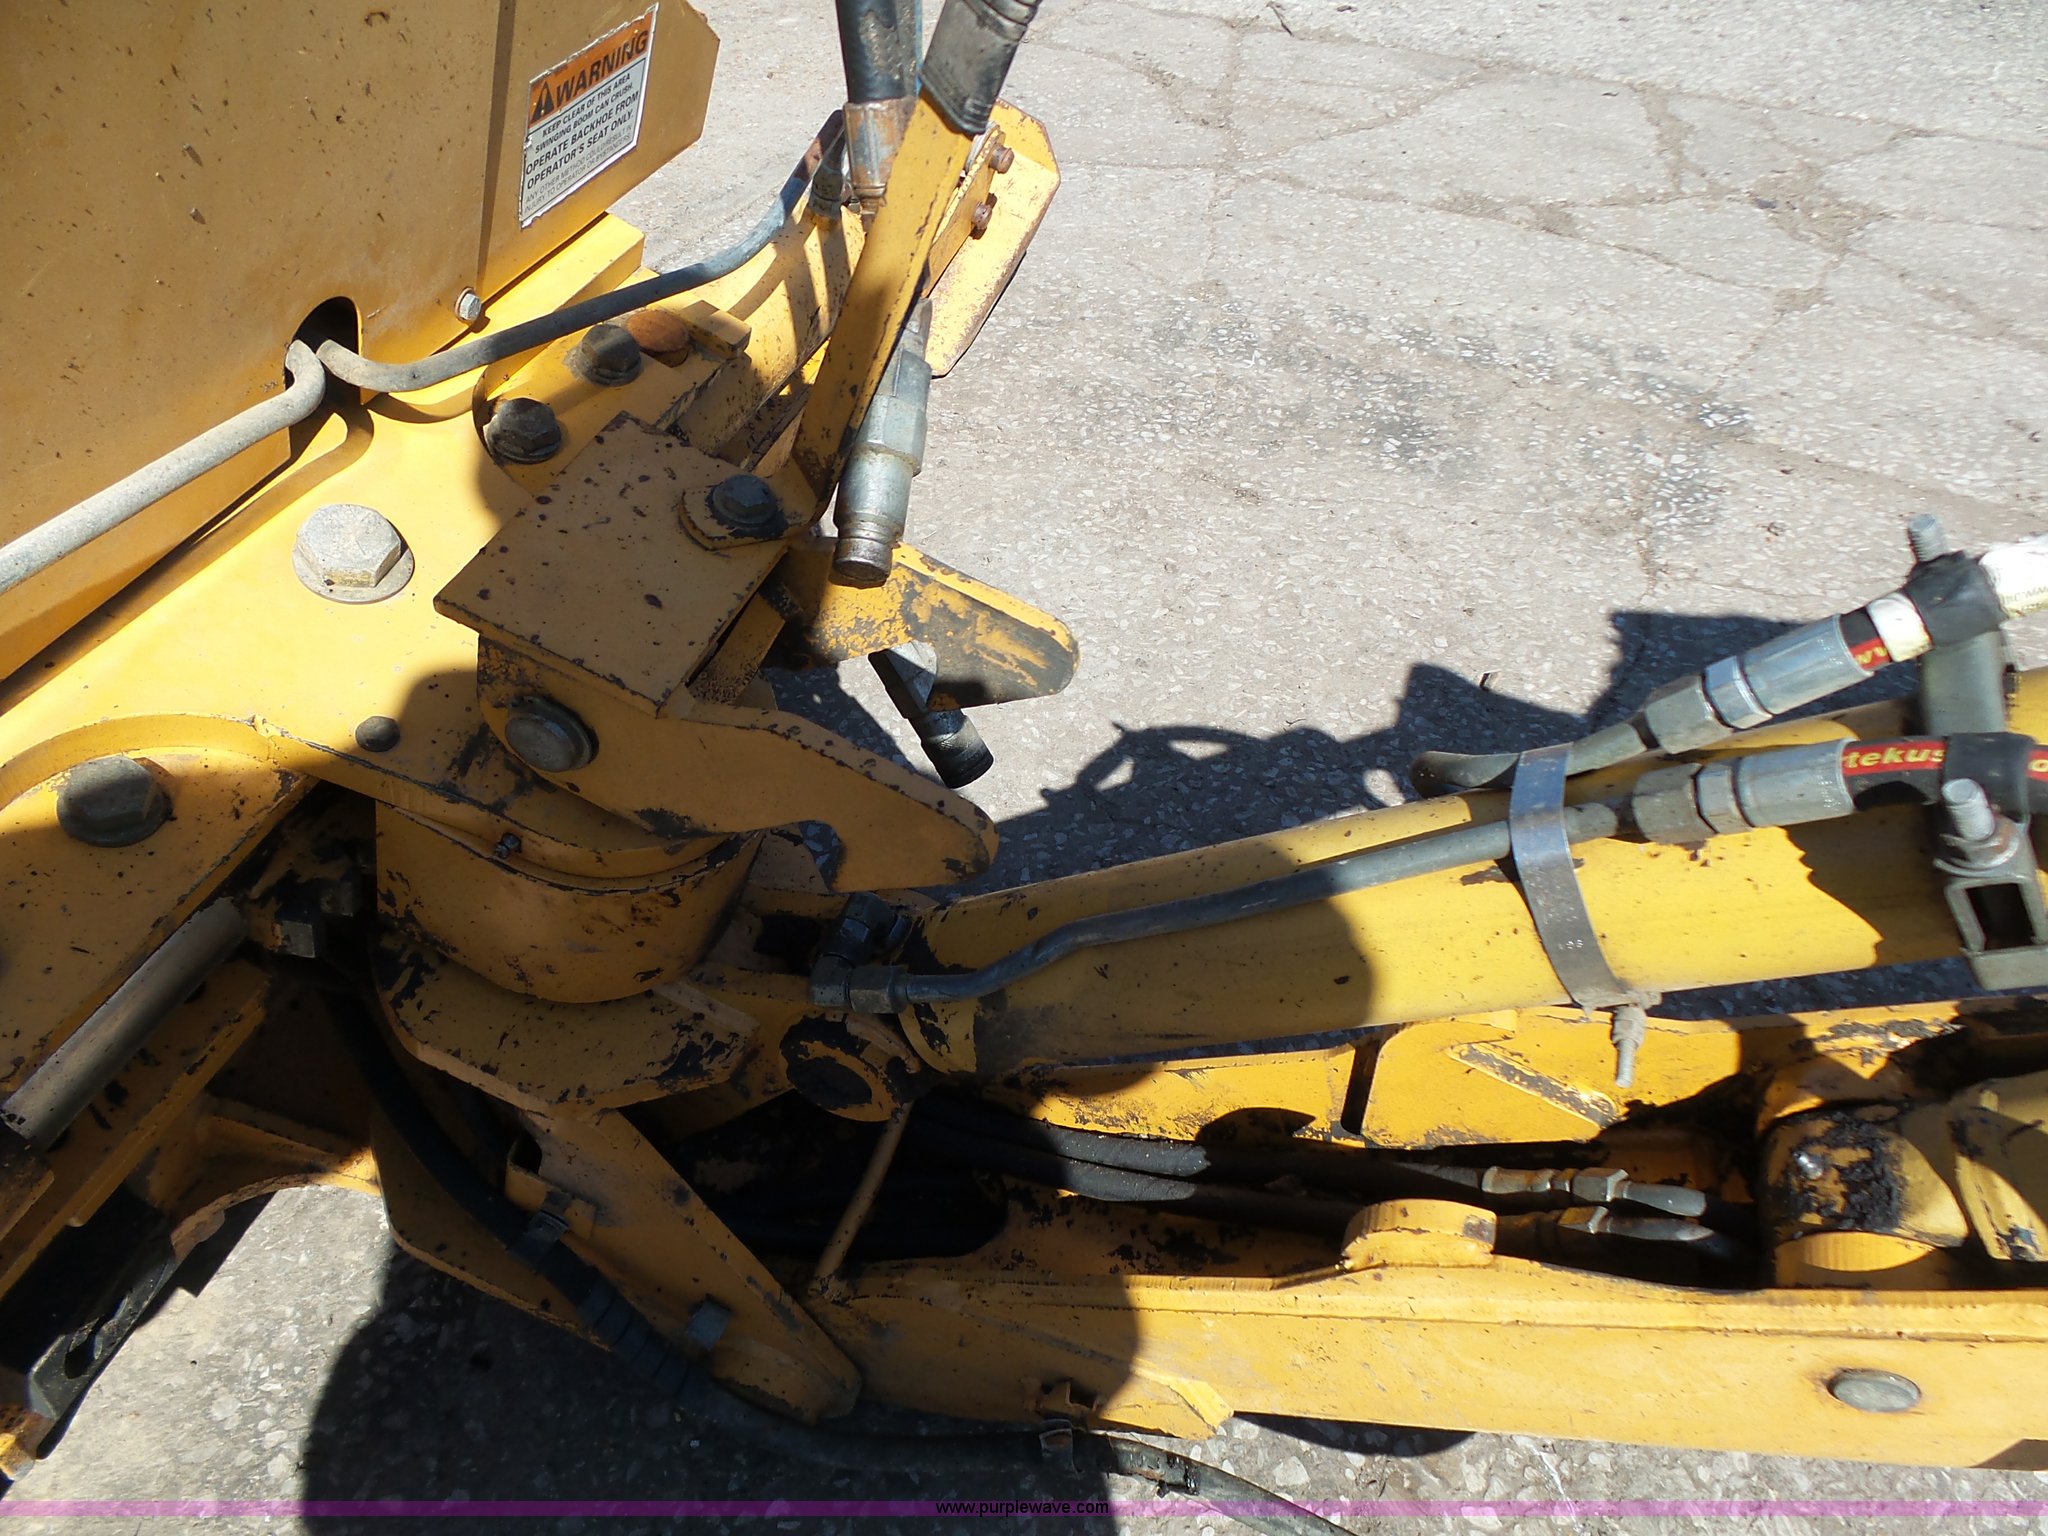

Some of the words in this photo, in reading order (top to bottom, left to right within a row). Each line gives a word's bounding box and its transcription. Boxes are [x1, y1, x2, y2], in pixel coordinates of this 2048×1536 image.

[555, 31, 648, 108] WARNING
[525, 139, 570, 176] OPERATE
[570, 107, 614, 146] BACKHOE
[615, 91, 640, 115] FROM
[535, 125, 572, 154] SWINGING
[572, 110, 594, 130] BOOM
[594, 99, 609, 114] CAN
[542, 121, 562, 138] KEEP
[562, 103, 586, 125] CLEAR
[586, 97, 596, 109] OF
[597, 85, 612, 101] THIS
[613, 73, 631, 91] AREA
[526, 190, 538, 203] ANY
[539, 175, 560, 194] OTHER
[560, 157, 585, 179] METHOD
[527, 143, 585, 190] OPERATOR'S
[587, 126, 610, 151] SEAT
[610, 109, 634, 131] ONLY.
